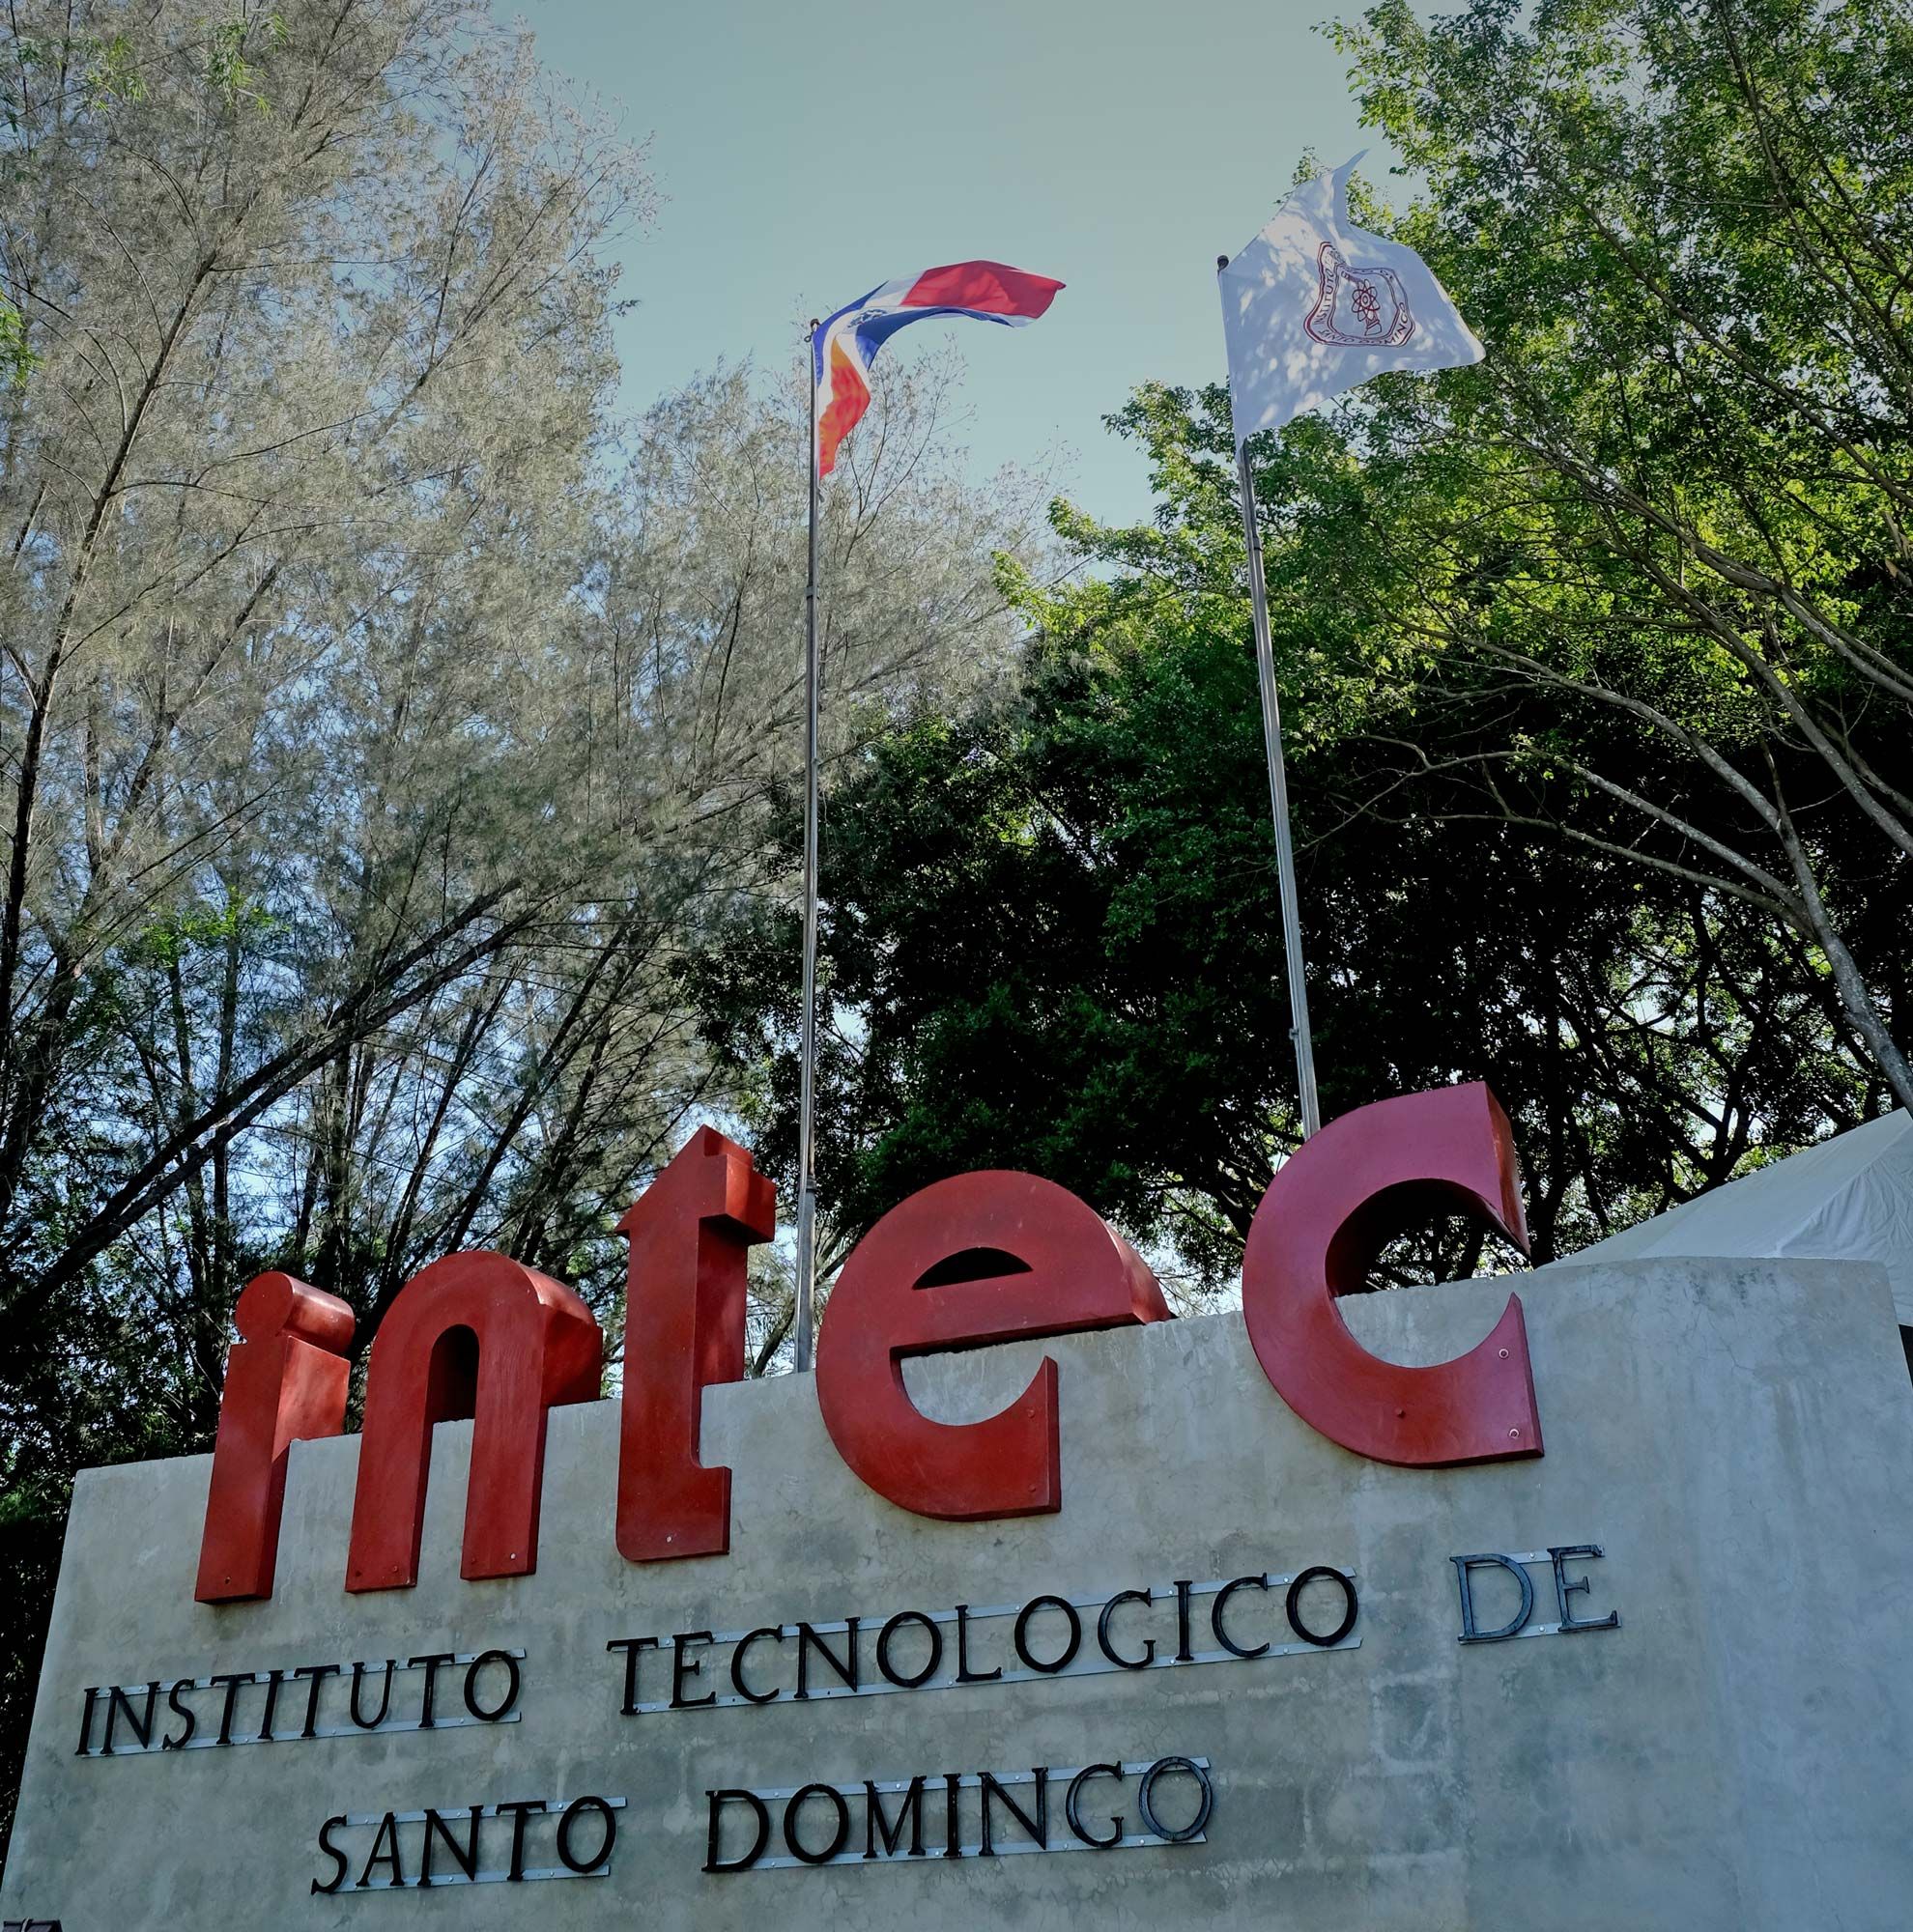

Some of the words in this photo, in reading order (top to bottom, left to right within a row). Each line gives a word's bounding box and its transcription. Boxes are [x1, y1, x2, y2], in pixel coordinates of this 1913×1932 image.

[195, 1080, 1543, 1604] intec
[74, 1649, 521, 1756] INSTITUTO
[606, 1565, 1358, 1716] TECNOLOGICO
[1449, 1544, 1619, 1642] DE
[310, 1795, 617, 1895] SANTO
[701, 1756, 1213, 1873] DOMINGO
